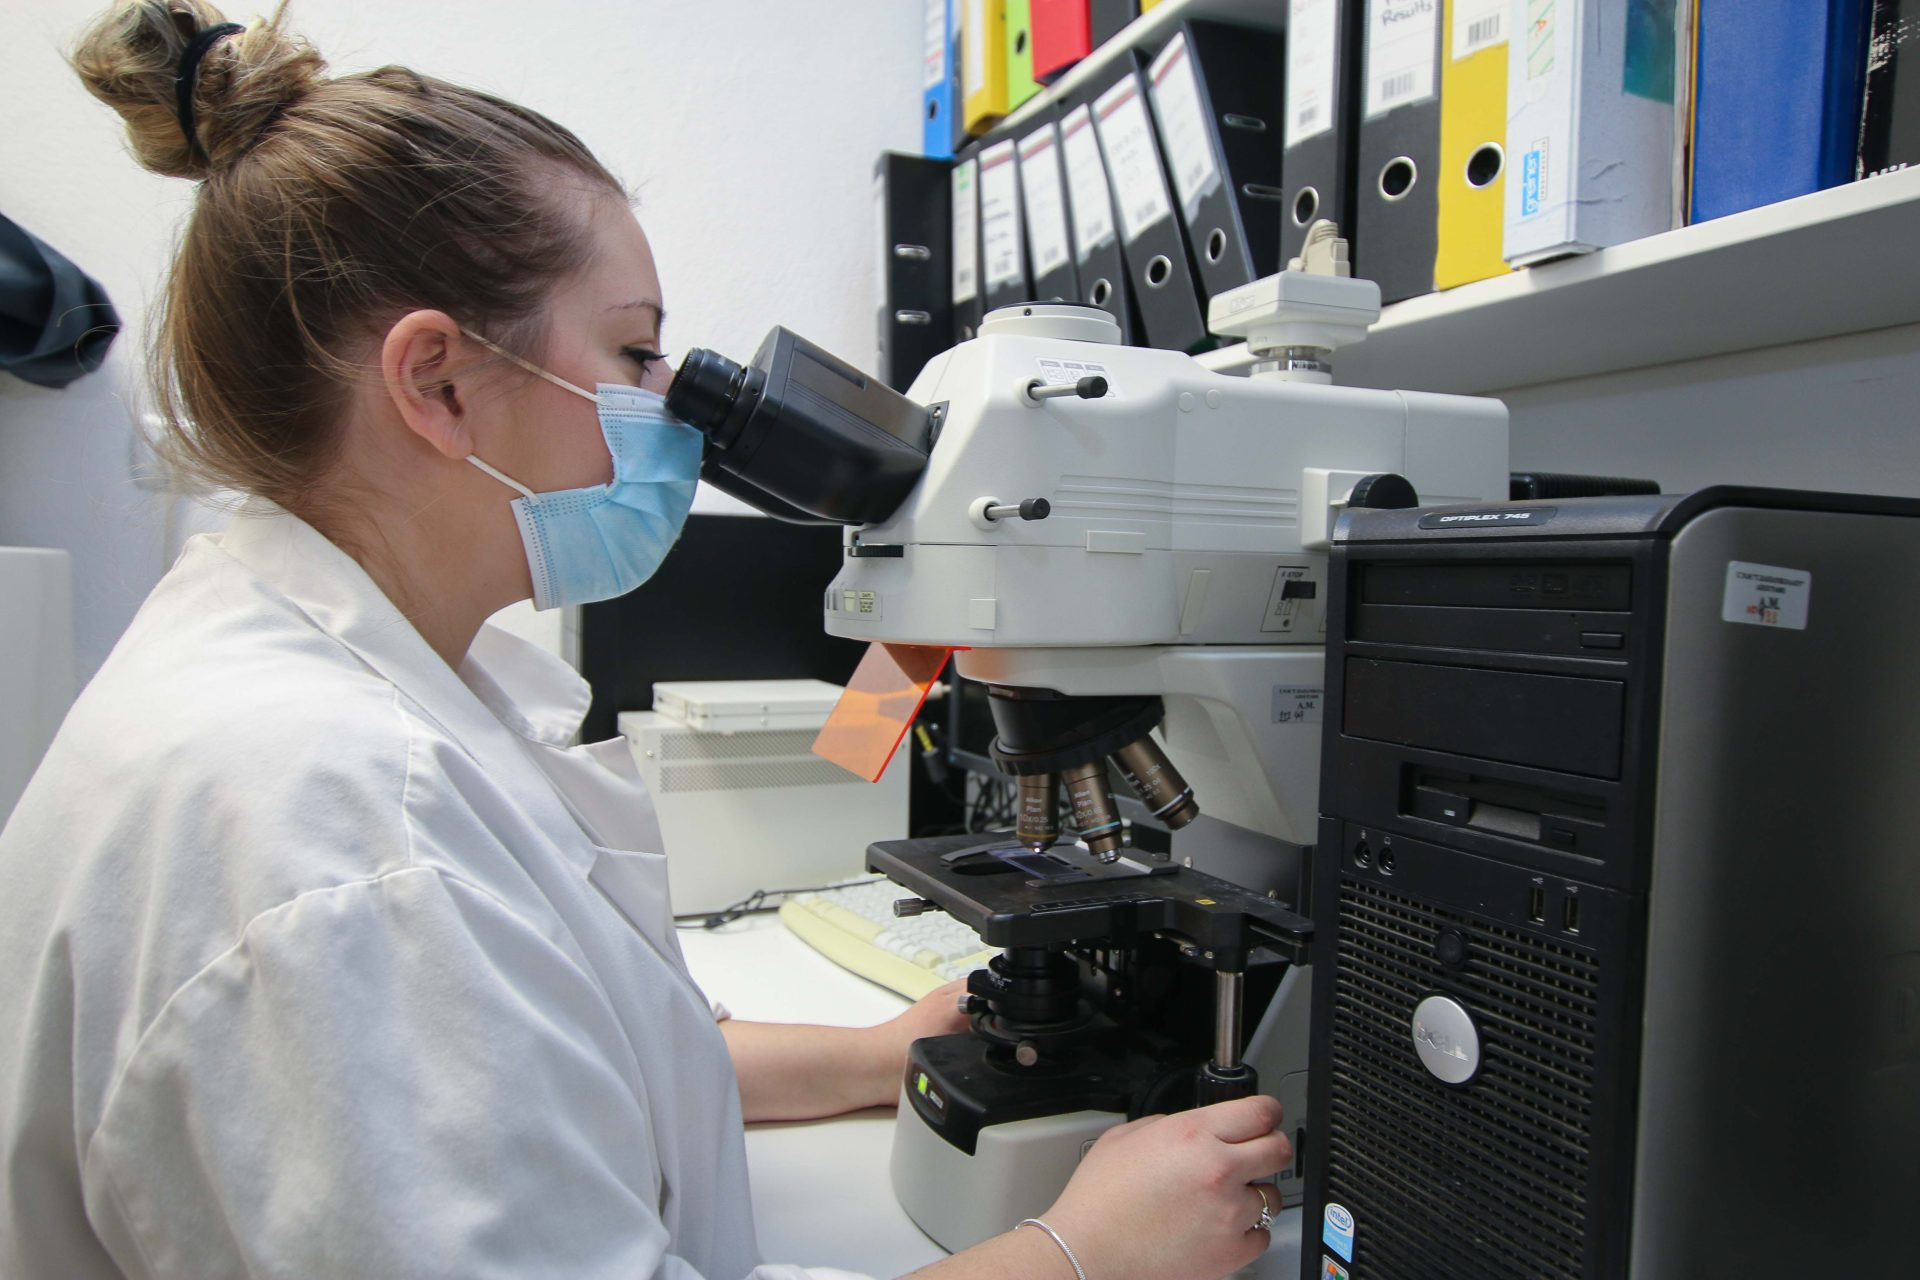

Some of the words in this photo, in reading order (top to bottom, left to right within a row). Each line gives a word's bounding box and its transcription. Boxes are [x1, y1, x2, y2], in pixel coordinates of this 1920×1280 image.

[1440, 513, 1501, 522] OPTIPLEX
[1504, 512, 1532, 520] 745
[1330, 1208, 1348, 1227] intel
